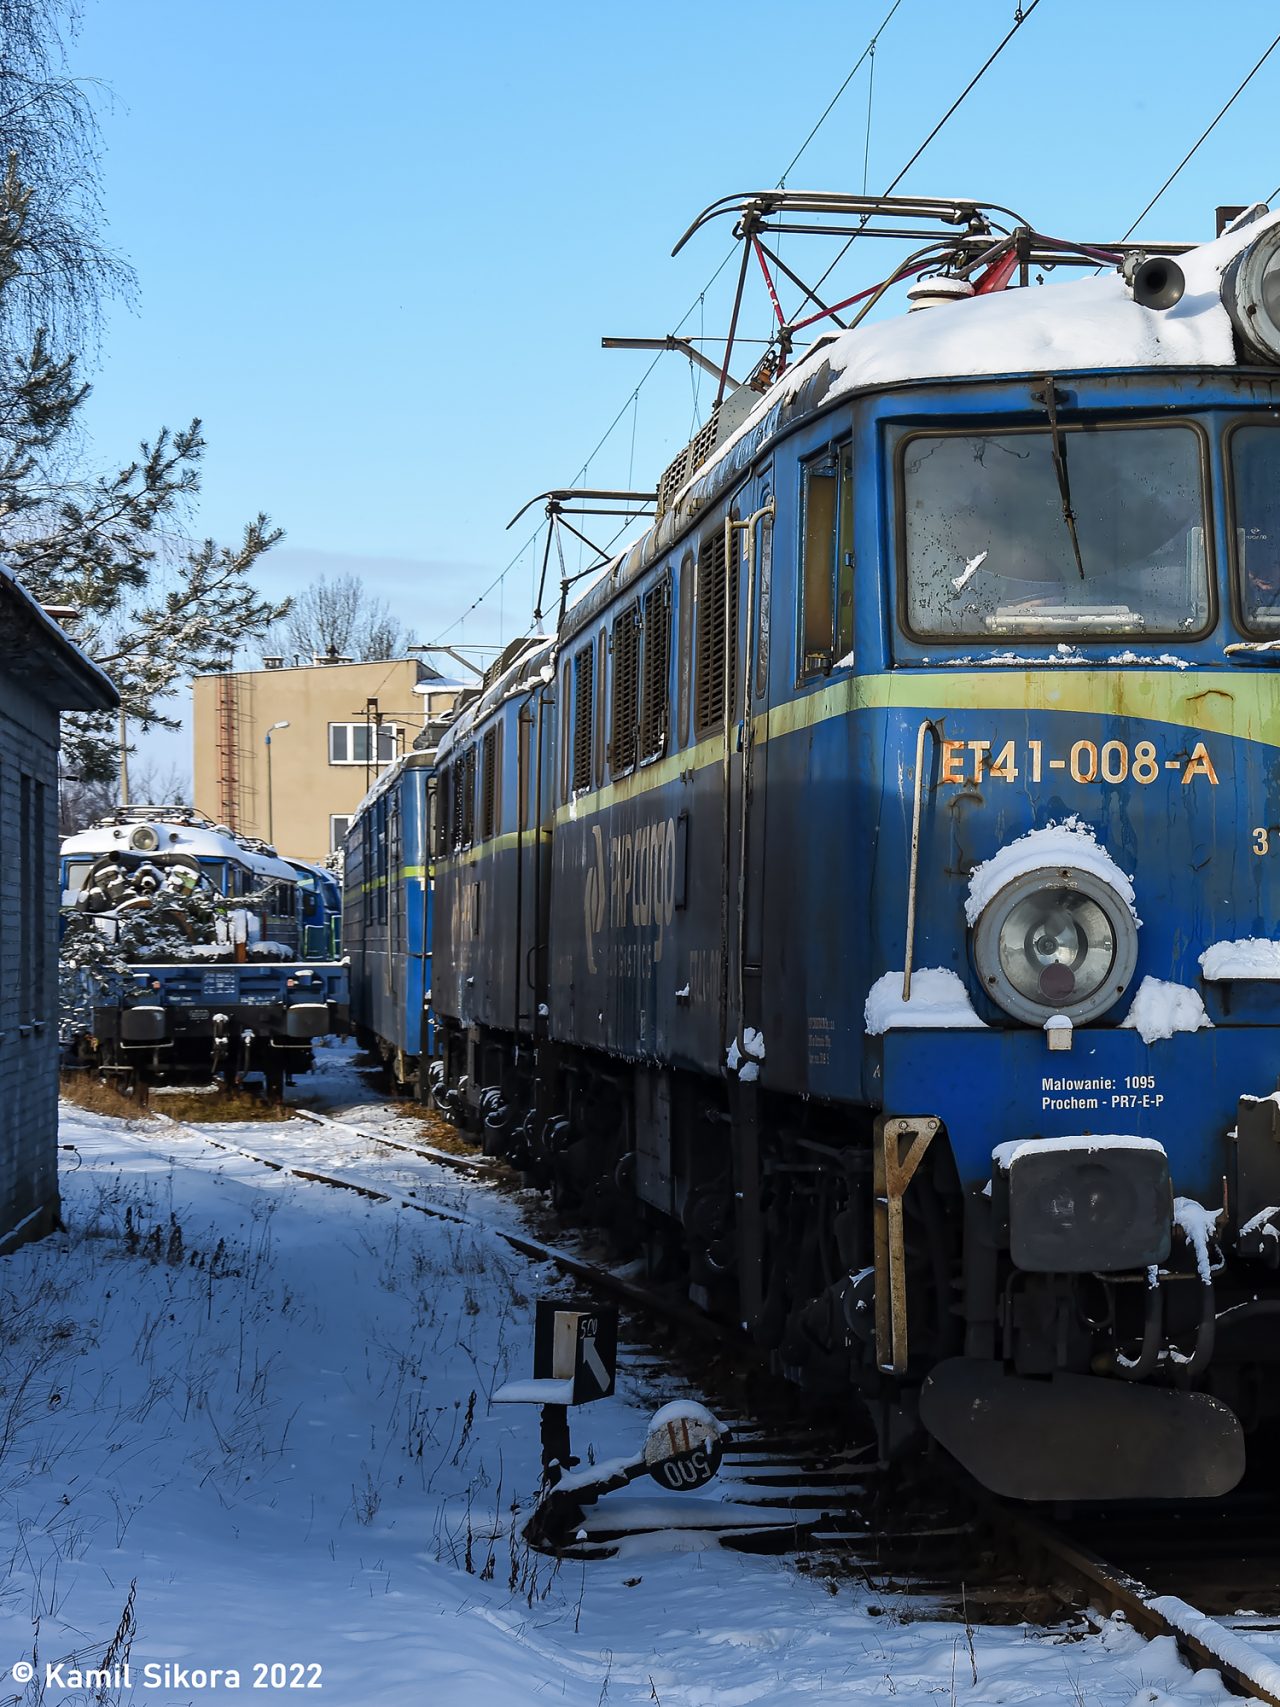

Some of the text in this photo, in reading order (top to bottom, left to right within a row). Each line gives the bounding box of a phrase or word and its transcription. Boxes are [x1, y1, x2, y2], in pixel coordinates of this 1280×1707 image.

[941, 740, 1219, 785] ET41-008-A
[1252, 827, 1269, 856] 3
[1042, 1075, 1155, 1092] Malowanie: 1095
[1042, 1095, 1098, 1110] Prochem
[1112, 1094, 1164, 1109] PR7-E-P
